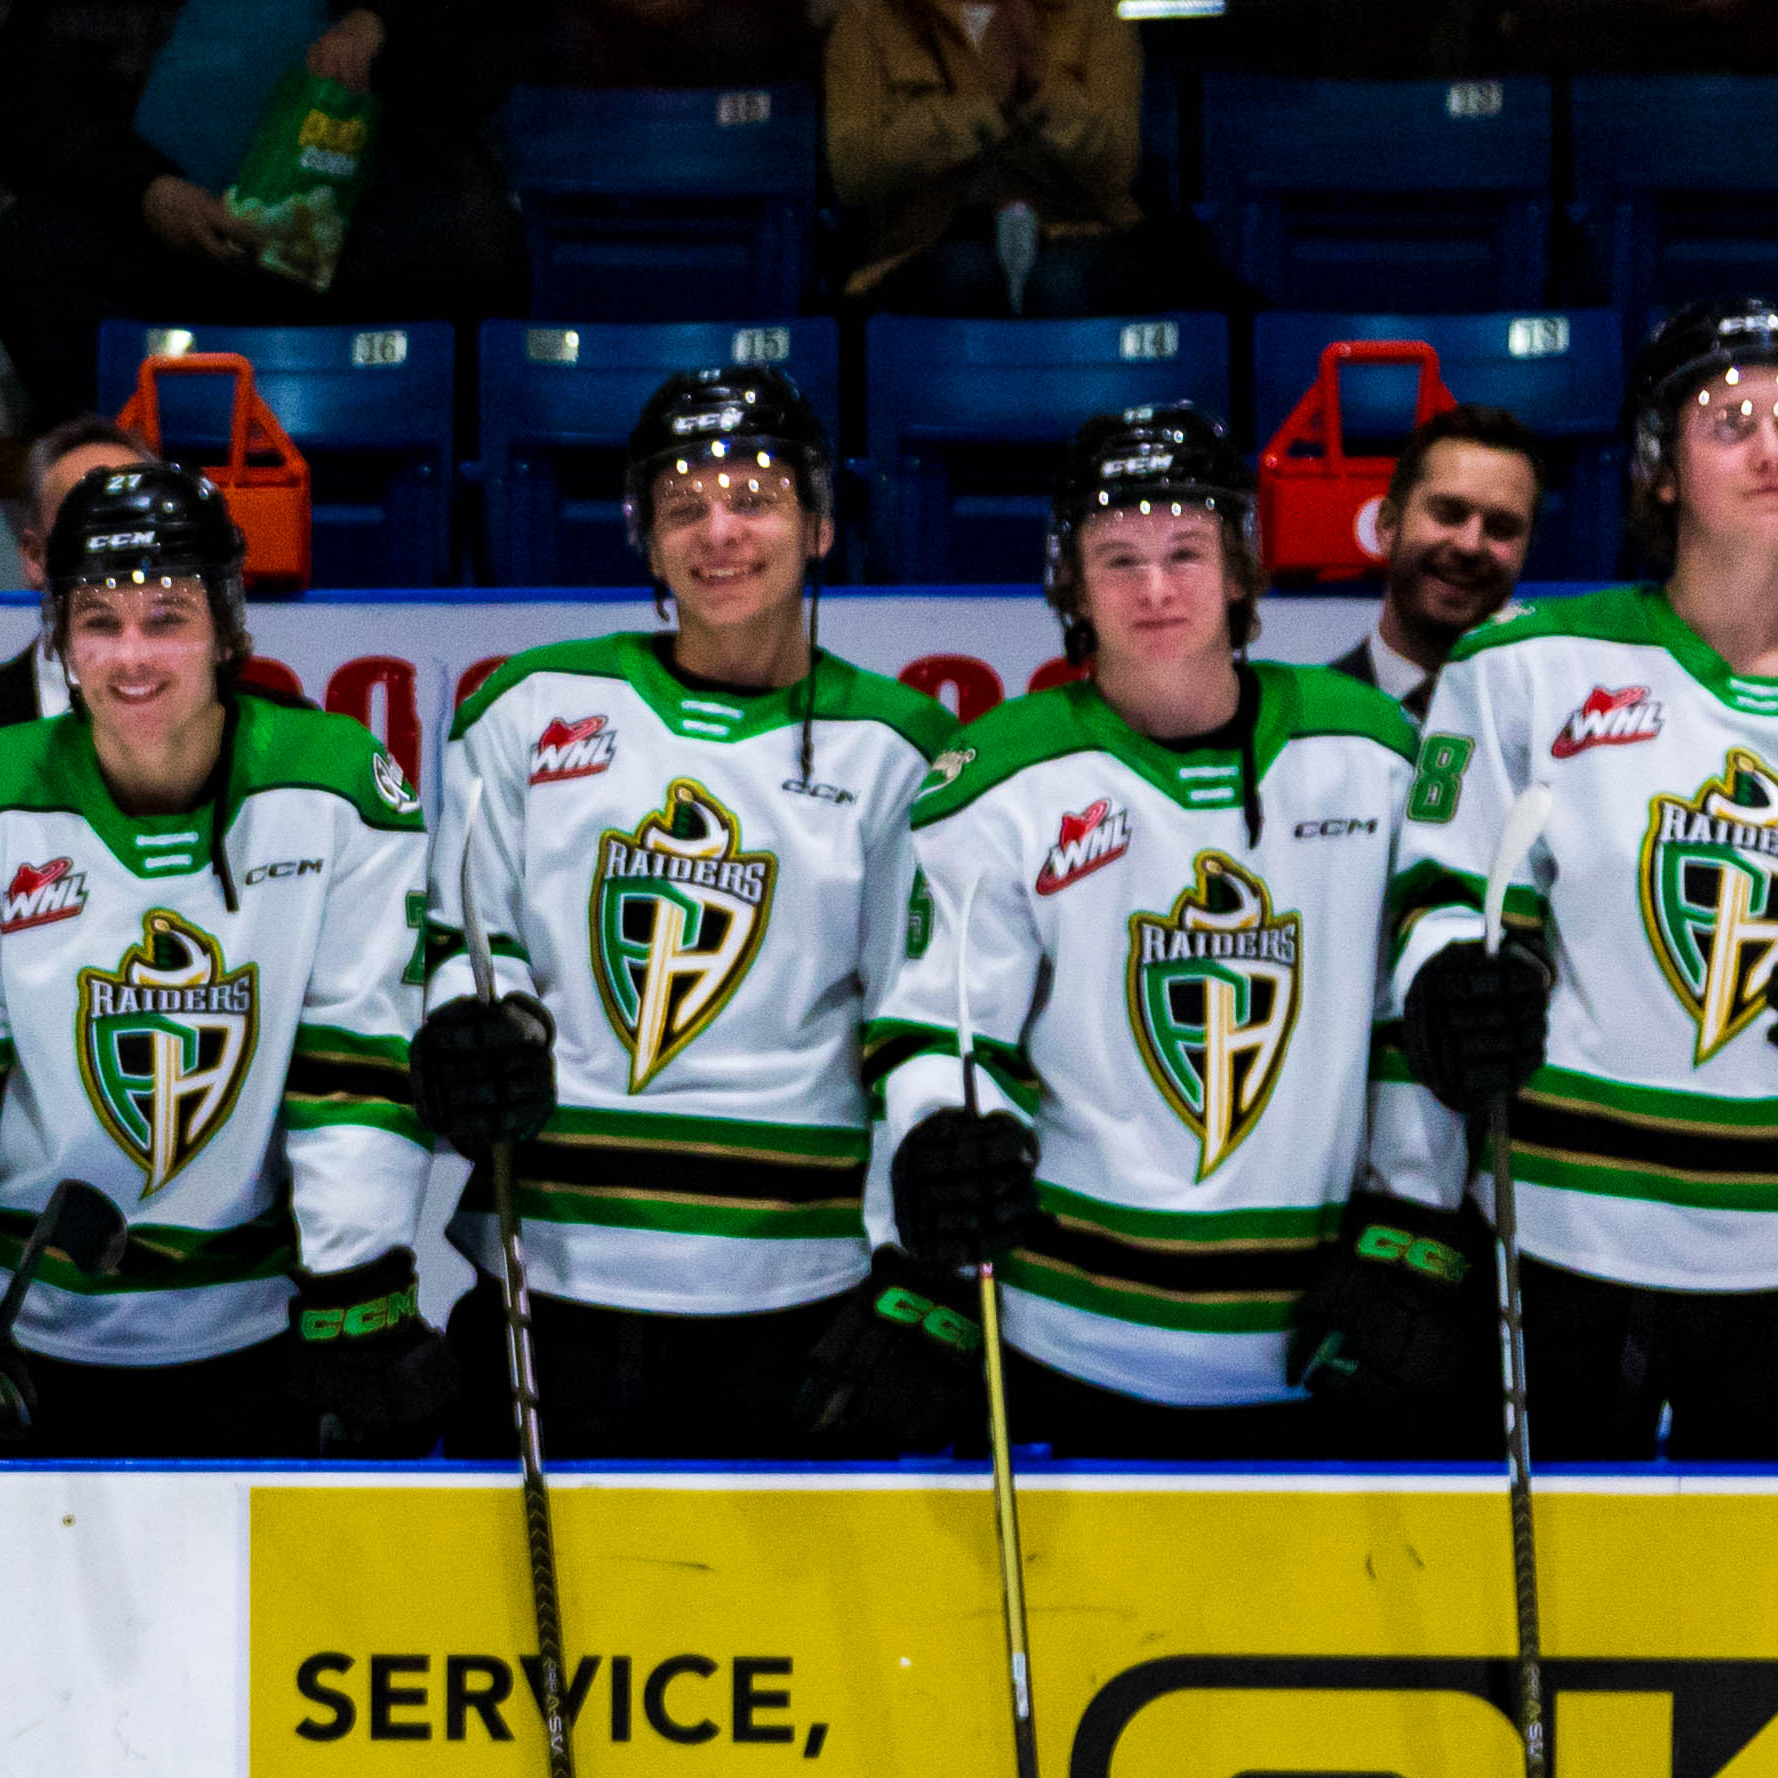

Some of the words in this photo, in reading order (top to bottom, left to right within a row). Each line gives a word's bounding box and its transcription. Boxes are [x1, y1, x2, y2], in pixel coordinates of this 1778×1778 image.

[104, 474, 143, 495] 27
[1100, 454, 1175, 479] CCM
[86, 531, 156, 552] CCM
[1572, 702, 1665, 740] WHL
[531, 730, 615, 772] WHL
[1406, 732, 1474, 824] 8
[1049, 810, 1131, 881] WHL
[1293, 816, 1379, 841] CCM
[1660, 805, 1778, 856] RAIDE
[245, 857, 325, 886] CCM
[605, 839, 768, 903] RAIDERS
[4, 873, 89, 922] WHL
[1144, 924, 1297, 966] RAIDERS
[90, 975, 252, 1018] RAIDERS
[299, 1284, 418, 1344] CCM
[294, 1651, 830, 1759] SERVICE,
